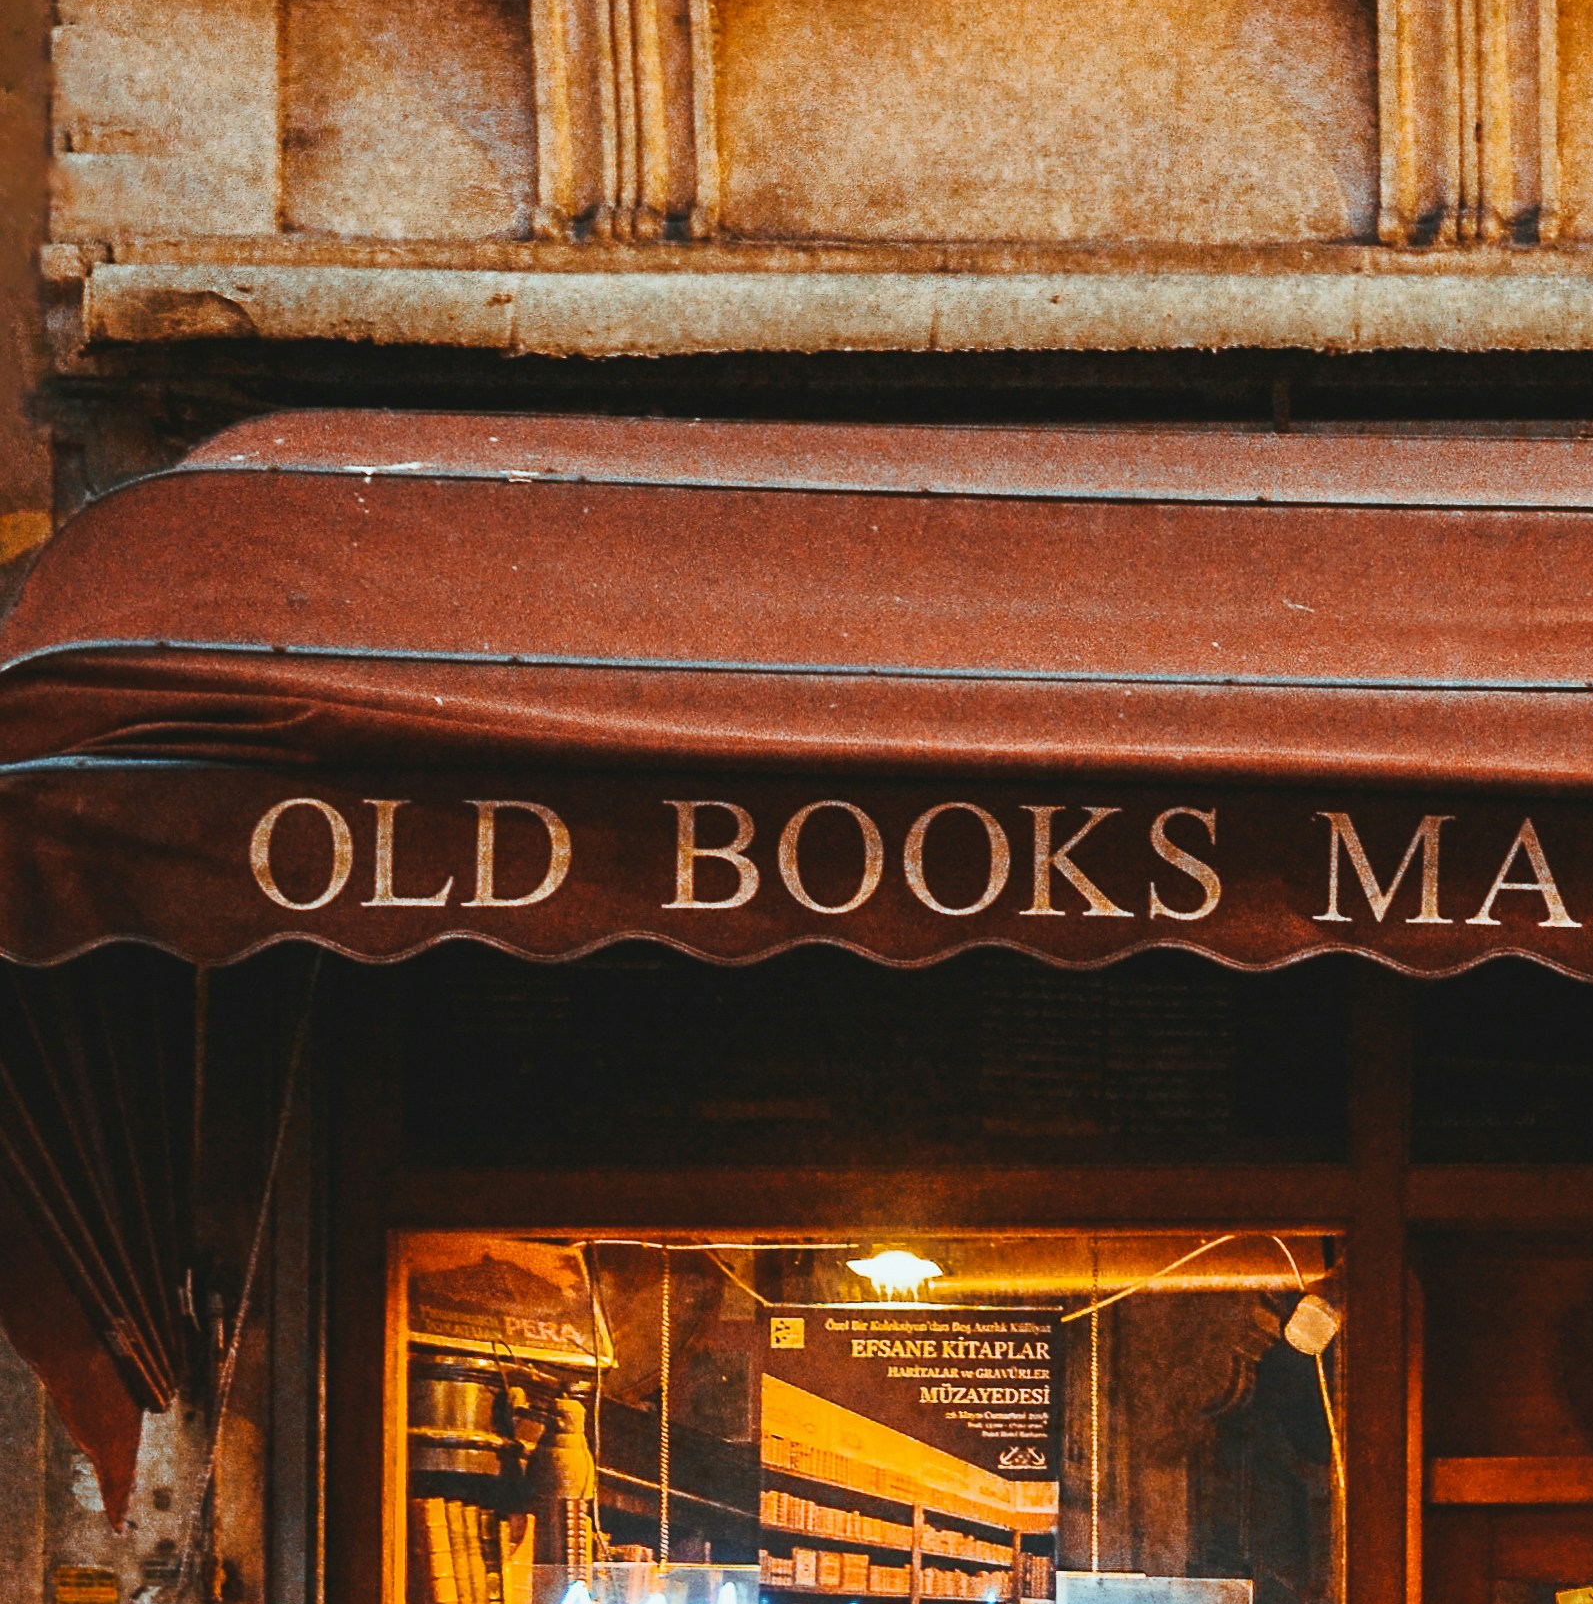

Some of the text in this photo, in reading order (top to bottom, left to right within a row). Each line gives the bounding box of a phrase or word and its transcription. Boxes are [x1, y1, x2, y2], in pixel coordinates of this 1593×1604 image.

[248, 798, 573, 910] OLD
[660, 799, 1222, 922] BOOKS
[851, 1337, 1051, 1359] EFSANE KİTAPLAR
[919, 1383, 1051, 1404] MÜZAYEDESİ
